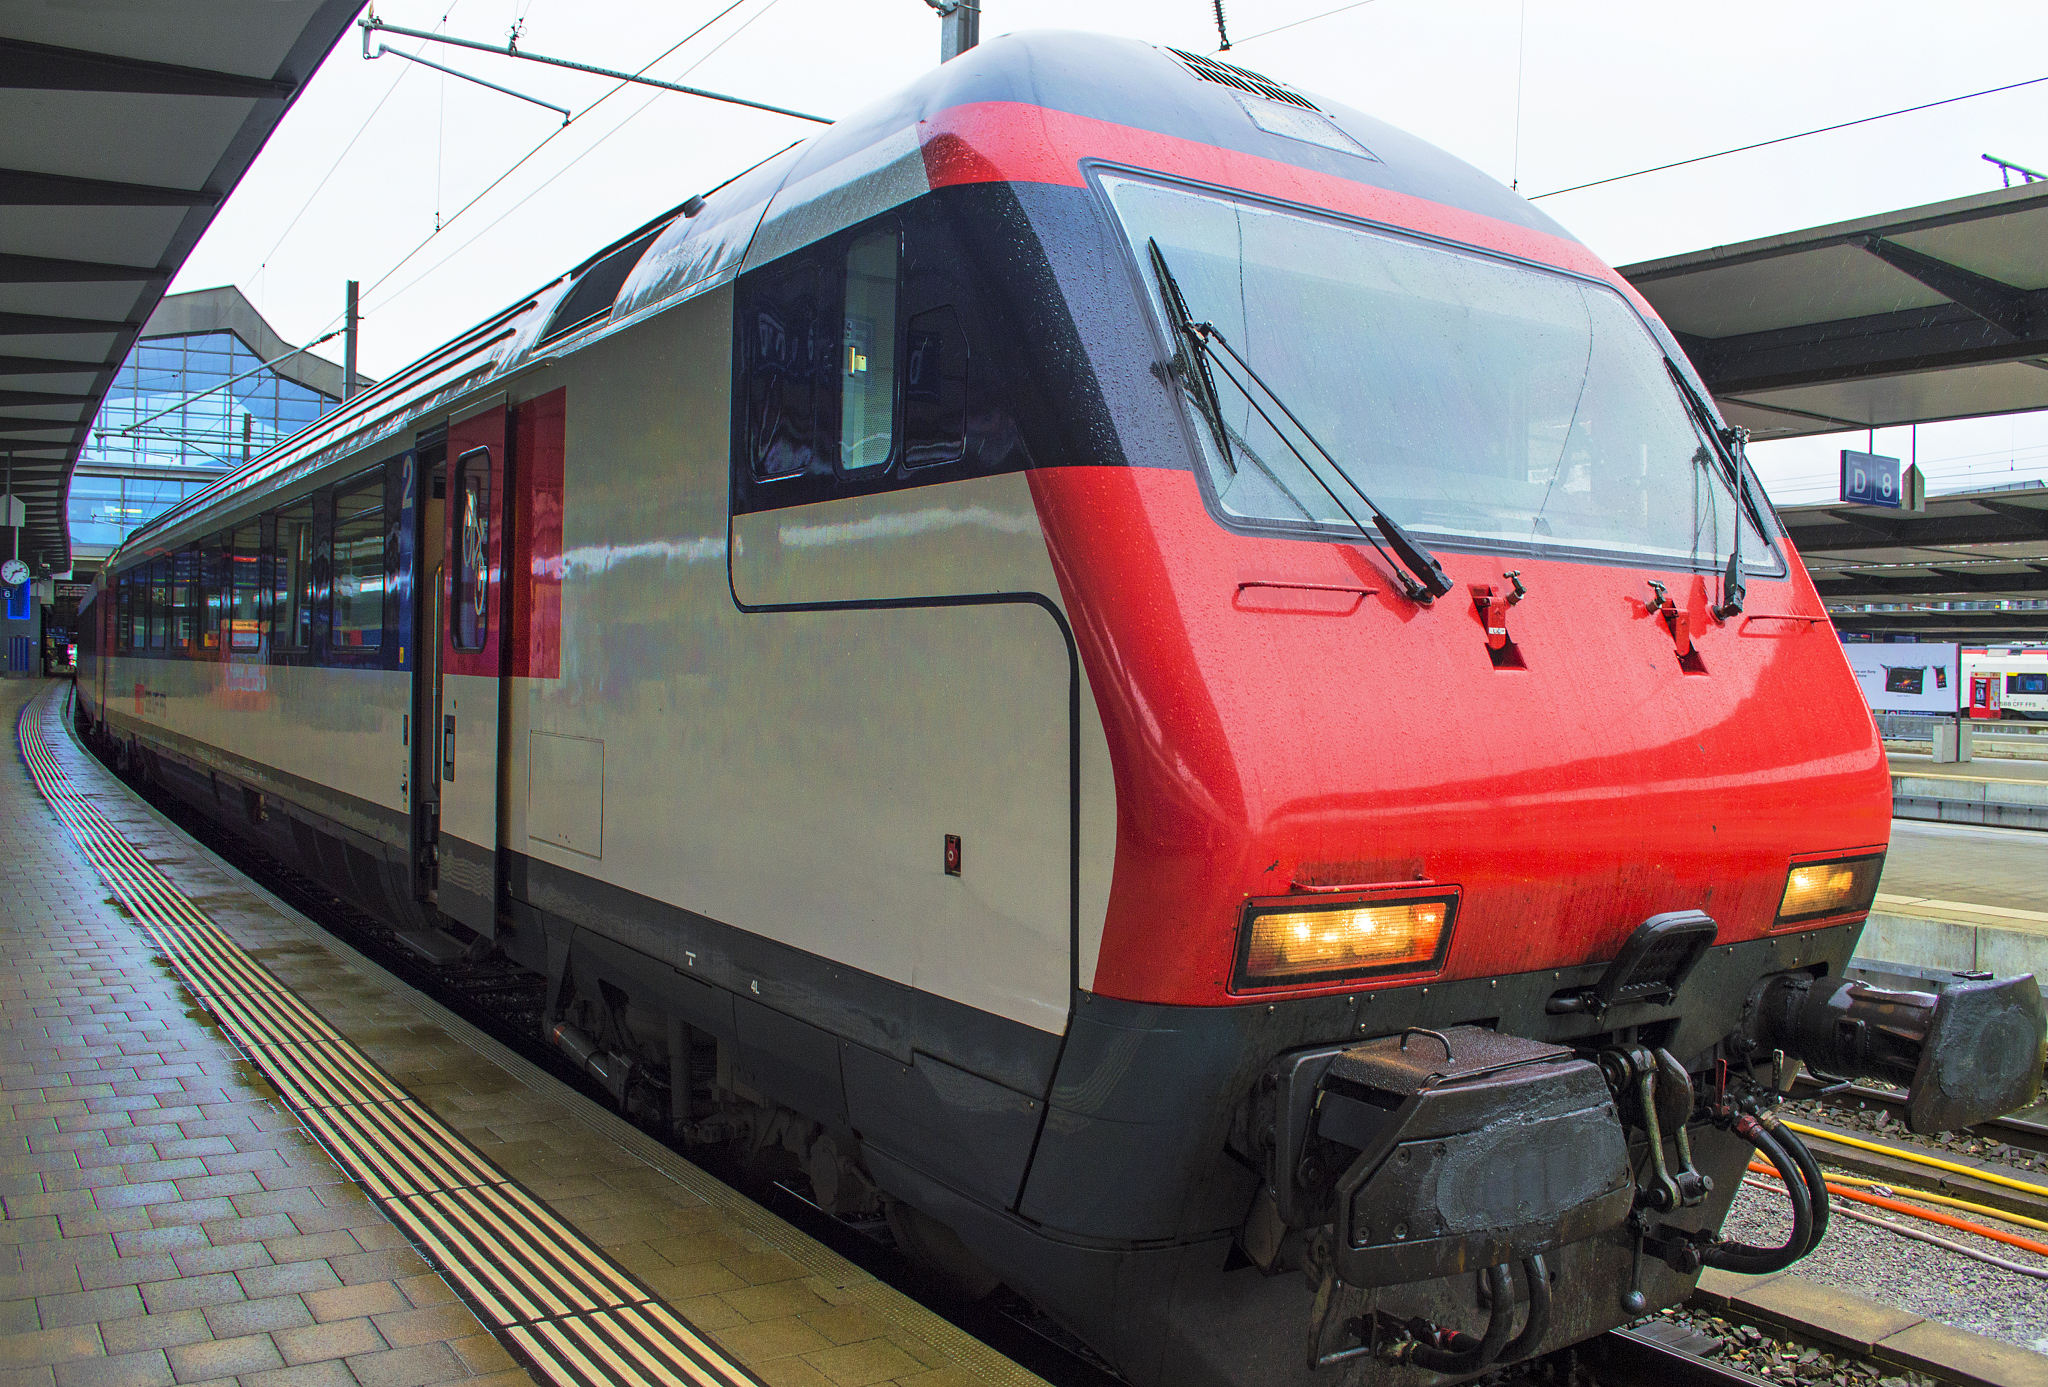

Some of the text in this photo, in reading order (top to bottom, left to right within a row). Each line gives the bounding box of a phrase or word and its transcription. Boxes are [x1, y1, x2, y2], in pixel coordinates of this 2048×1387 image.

[402, 455, 413, 509] 2
[1854, 468, 1867, 494] D
[1882, 472, 1893, 498] 8
